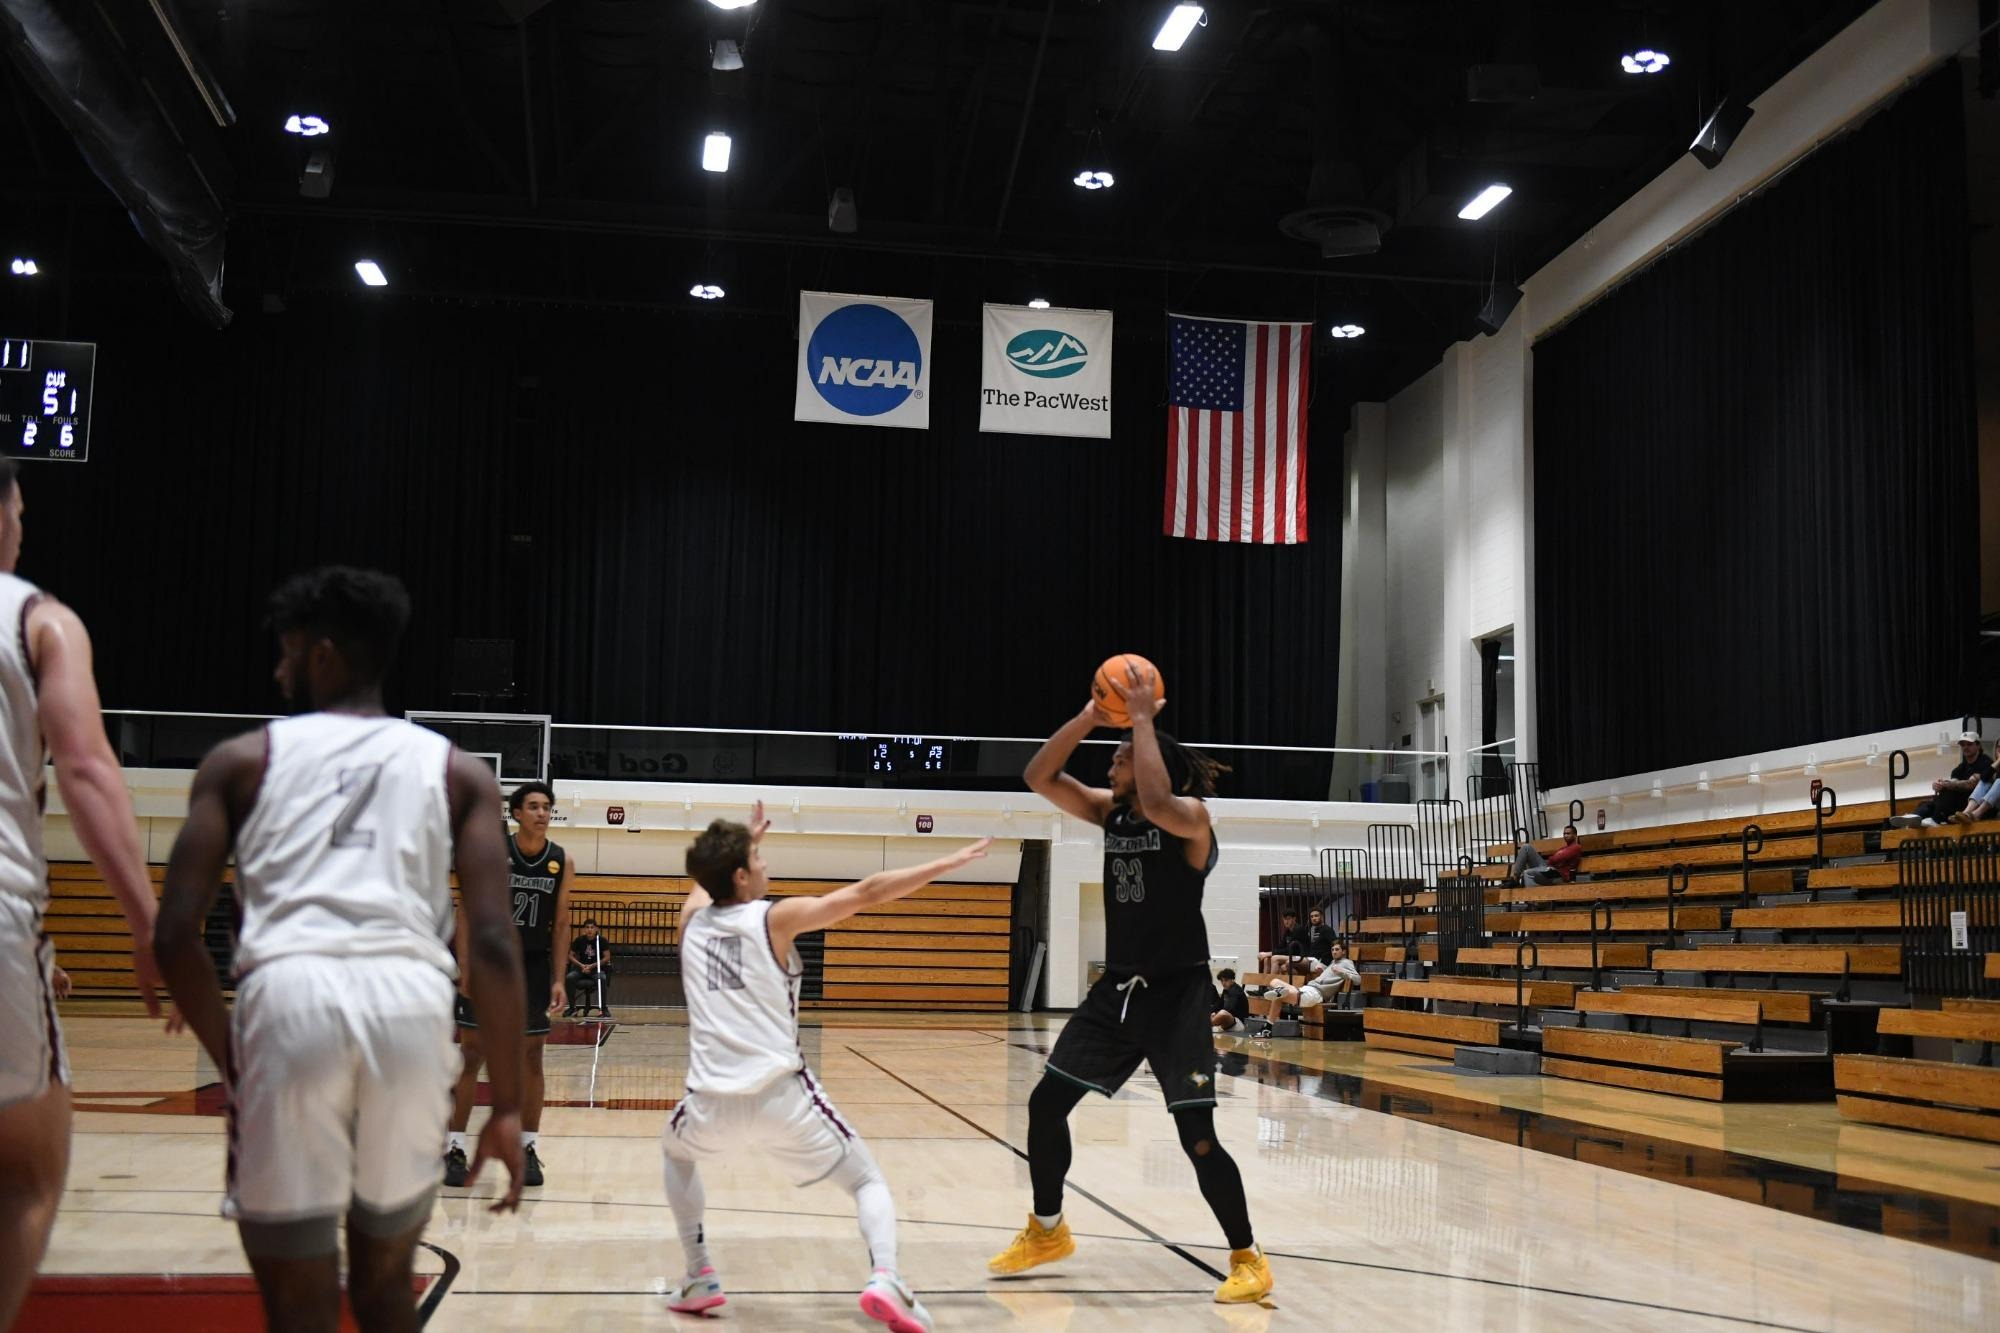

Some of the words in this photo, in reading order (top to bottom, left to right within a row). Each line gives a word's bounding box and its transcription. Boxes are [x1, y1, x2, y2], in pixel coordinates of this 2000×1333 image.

[818, 356, 917, 389] NCAA
[43, 387, 77, 415] 51
[983, 388, 1019, 406] The
[1024, 391, 1109, 411] PacWest
[52, 416, 79, 426] FOULS
[23, 422, 37, 445] 2
[60, 424, 73, 447] 6
[49, 449, 76, 458] SCORE
[330, 763, 382, 848] 2
[608, 812, 624, 820] 107
[1112, 857, 1145, 903] 33
[512, 891, 540, 928] 21
